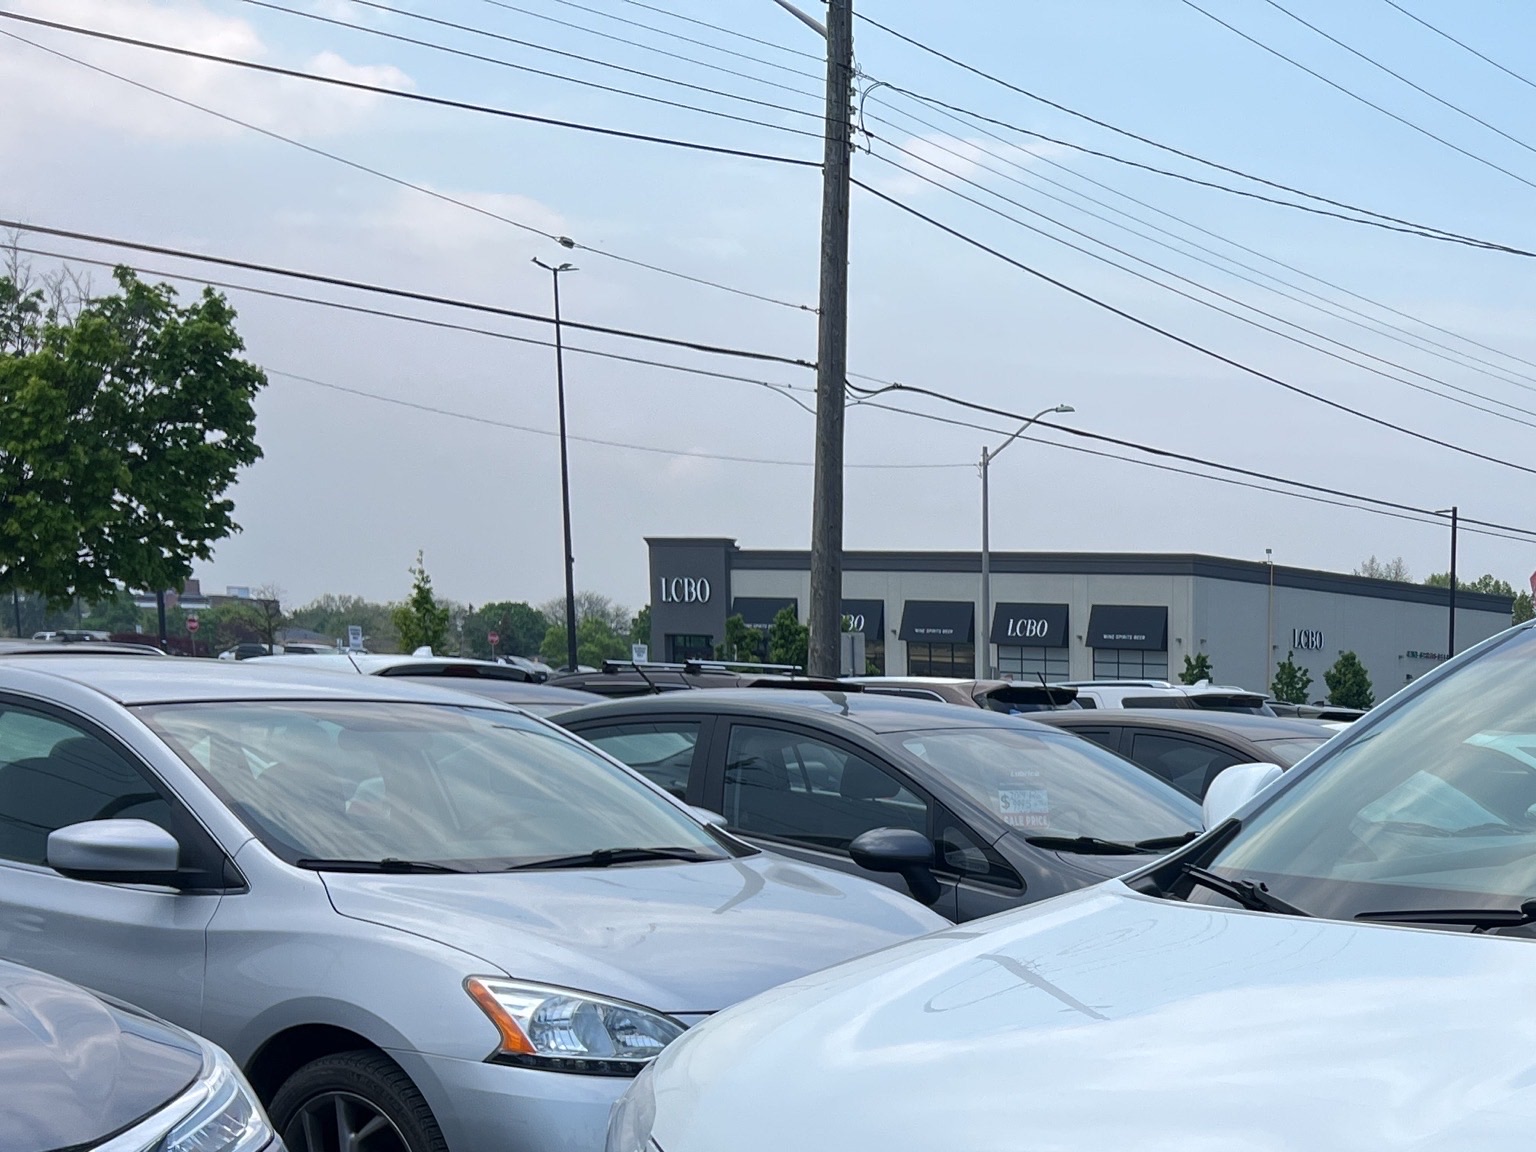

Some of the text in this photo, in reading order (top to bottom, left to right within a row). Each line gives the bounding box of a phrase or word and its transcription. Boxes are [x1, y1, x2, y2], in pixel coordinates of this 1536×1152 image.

[660, 577, 711, 604] LCBO
[1007, 618, 1048, 638] LCBO
[1293, 628, 1324, 650] LCBO
[1026, 815, 1048, 828] PRICE
